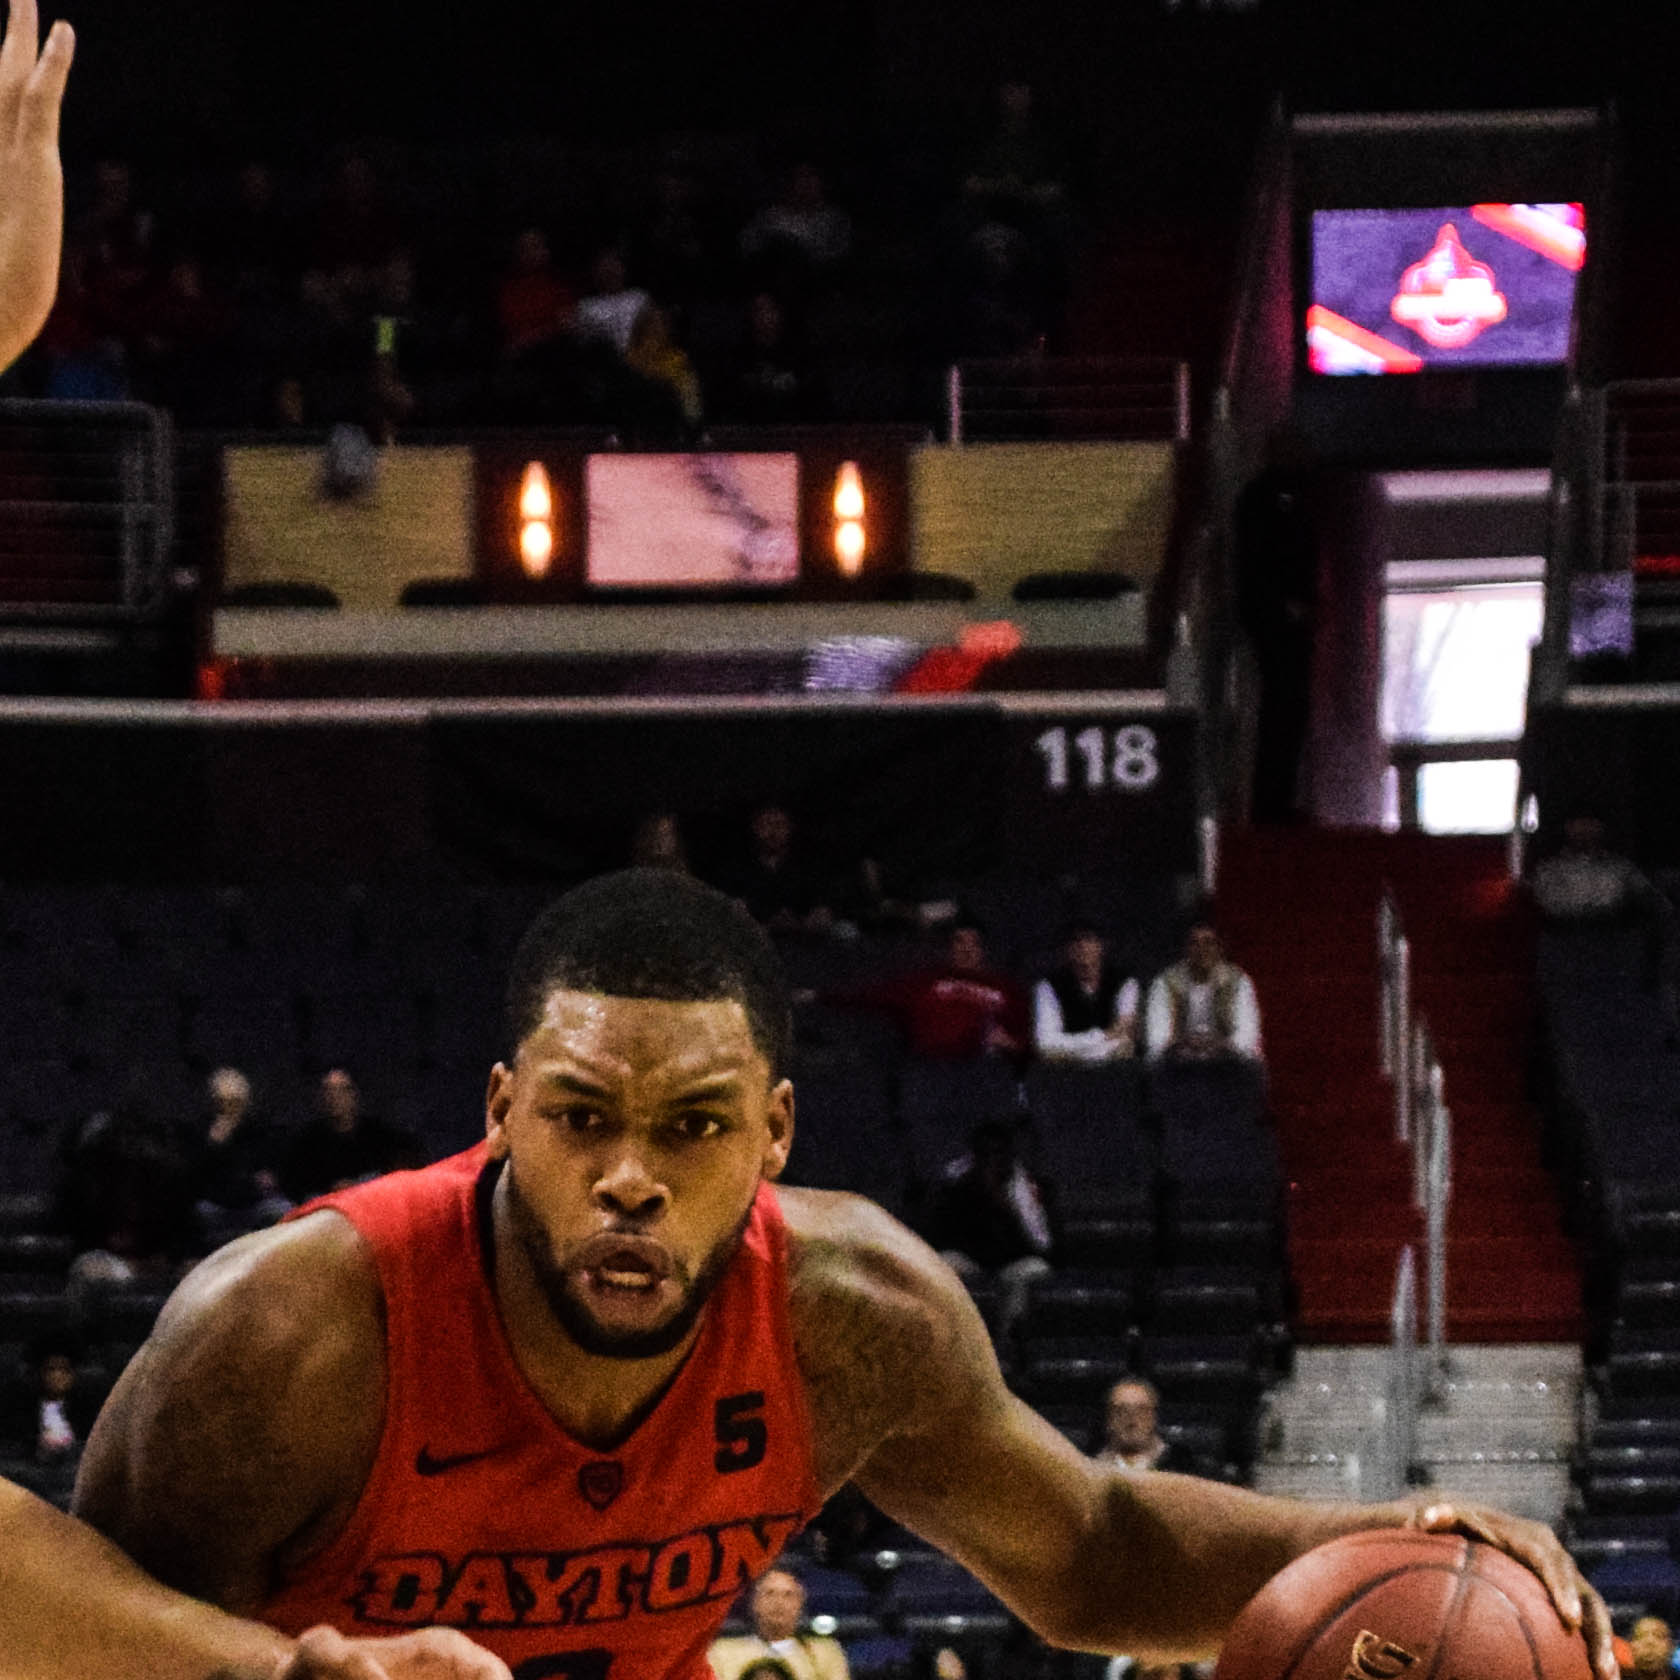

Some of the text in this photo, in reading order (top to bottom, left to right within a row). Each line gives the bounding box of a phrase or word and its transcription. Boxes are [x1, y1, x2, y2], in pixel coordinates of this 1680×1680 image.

[1032, 724, 1160, 789] 118
[714, 1391, 768, 1474] 5
[352, 1509, 805, 1629] DAYTON
